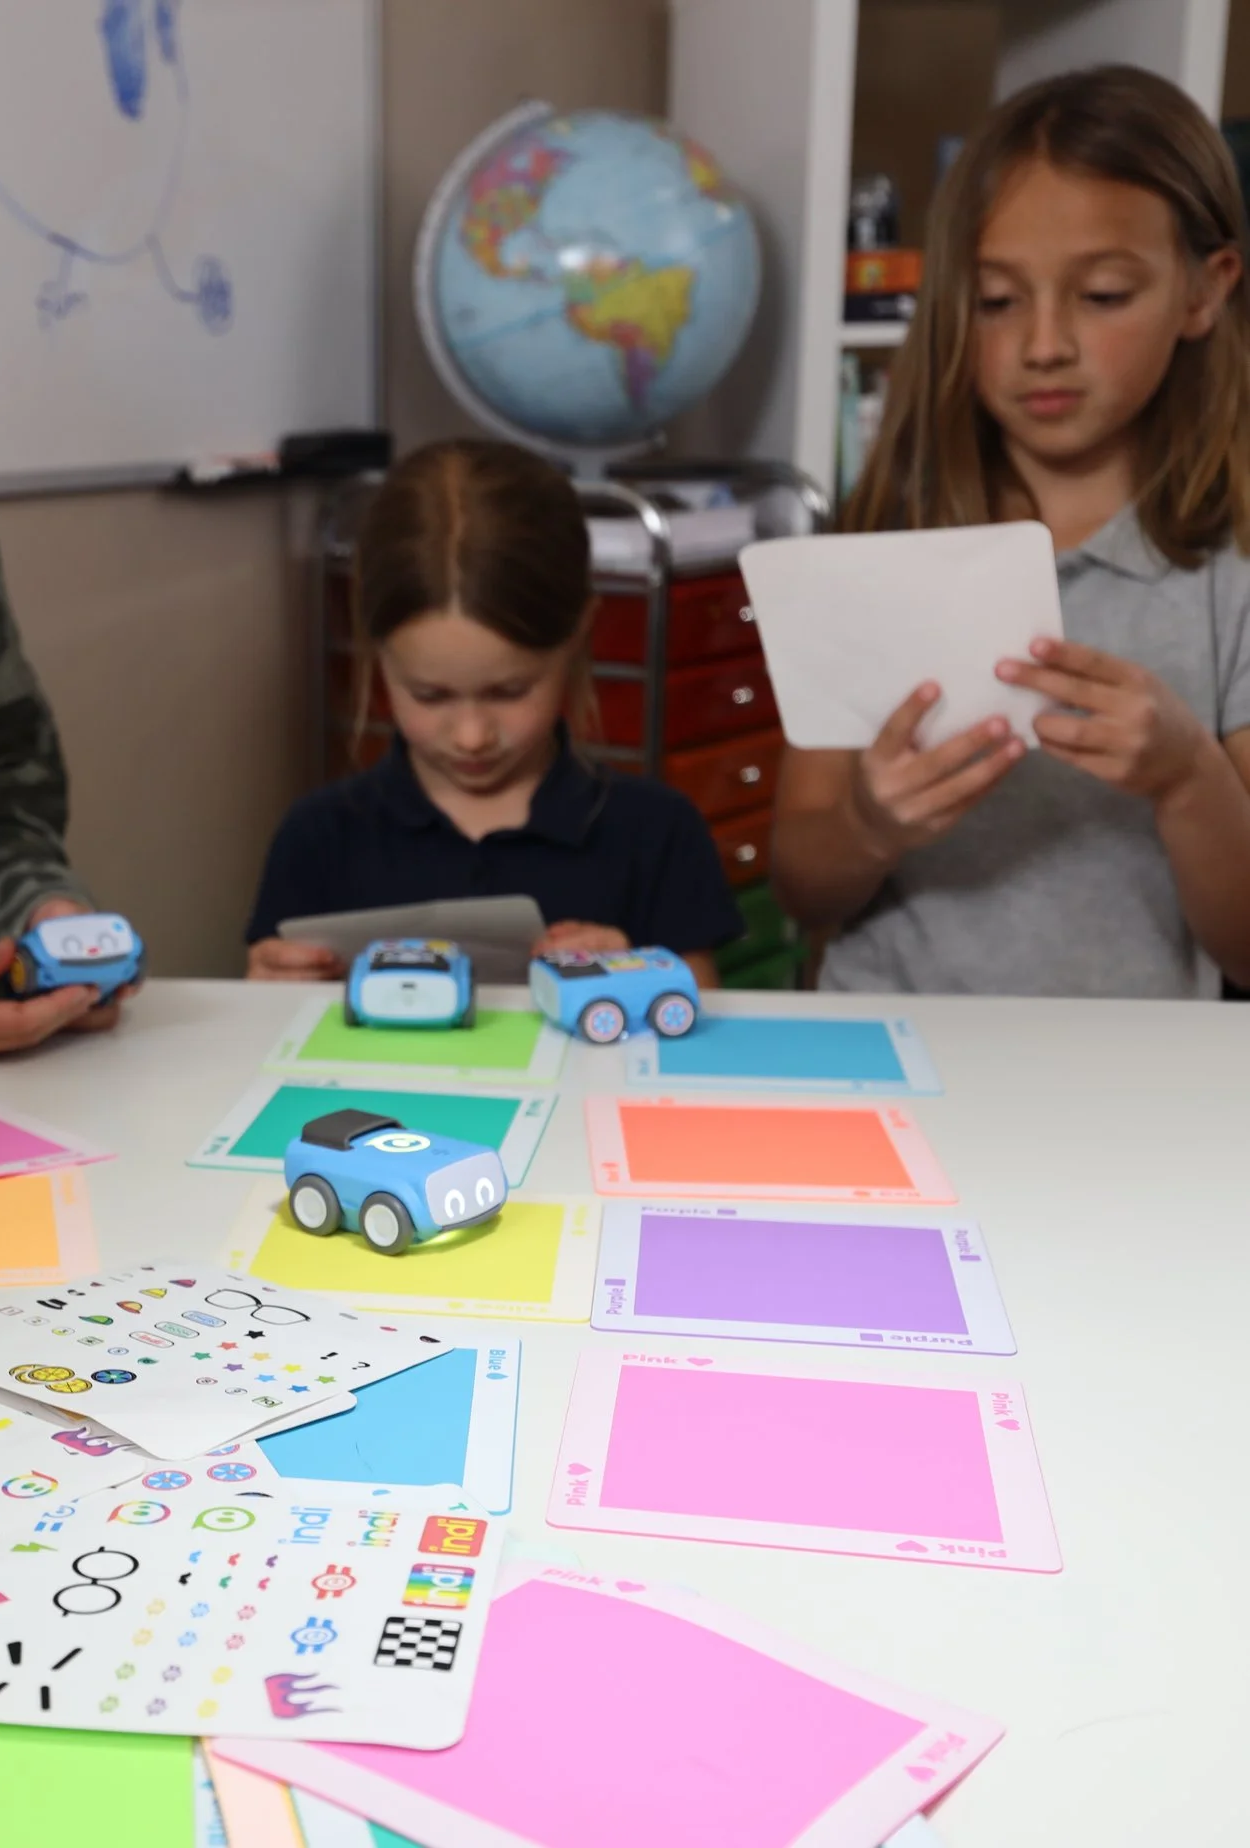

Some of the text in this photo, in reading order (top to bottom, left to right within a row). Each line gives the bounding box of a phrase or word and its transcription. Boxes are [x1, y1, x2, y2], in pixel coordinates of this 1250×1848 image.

[954, 1229, 972, 1255] Purple
[606, 1287, 627, 1315] Purple
[890, 1332, 974, 1347] Purple
[488, 1349, 506, 1371] Blue
[622, 1353, 678, 1365] Pink
[991, 1392, 1014, 1416] Pink
[565, 1479, 590, 1507] Pink
[278, 1506, 333, 1545] indi
[346, 1509, 401, 1548] indi
[428, 1518, 478, 1555] indi
[938, 1543, 1008, 1558] Pink
[541, 1568, 606, 1587] Pink
